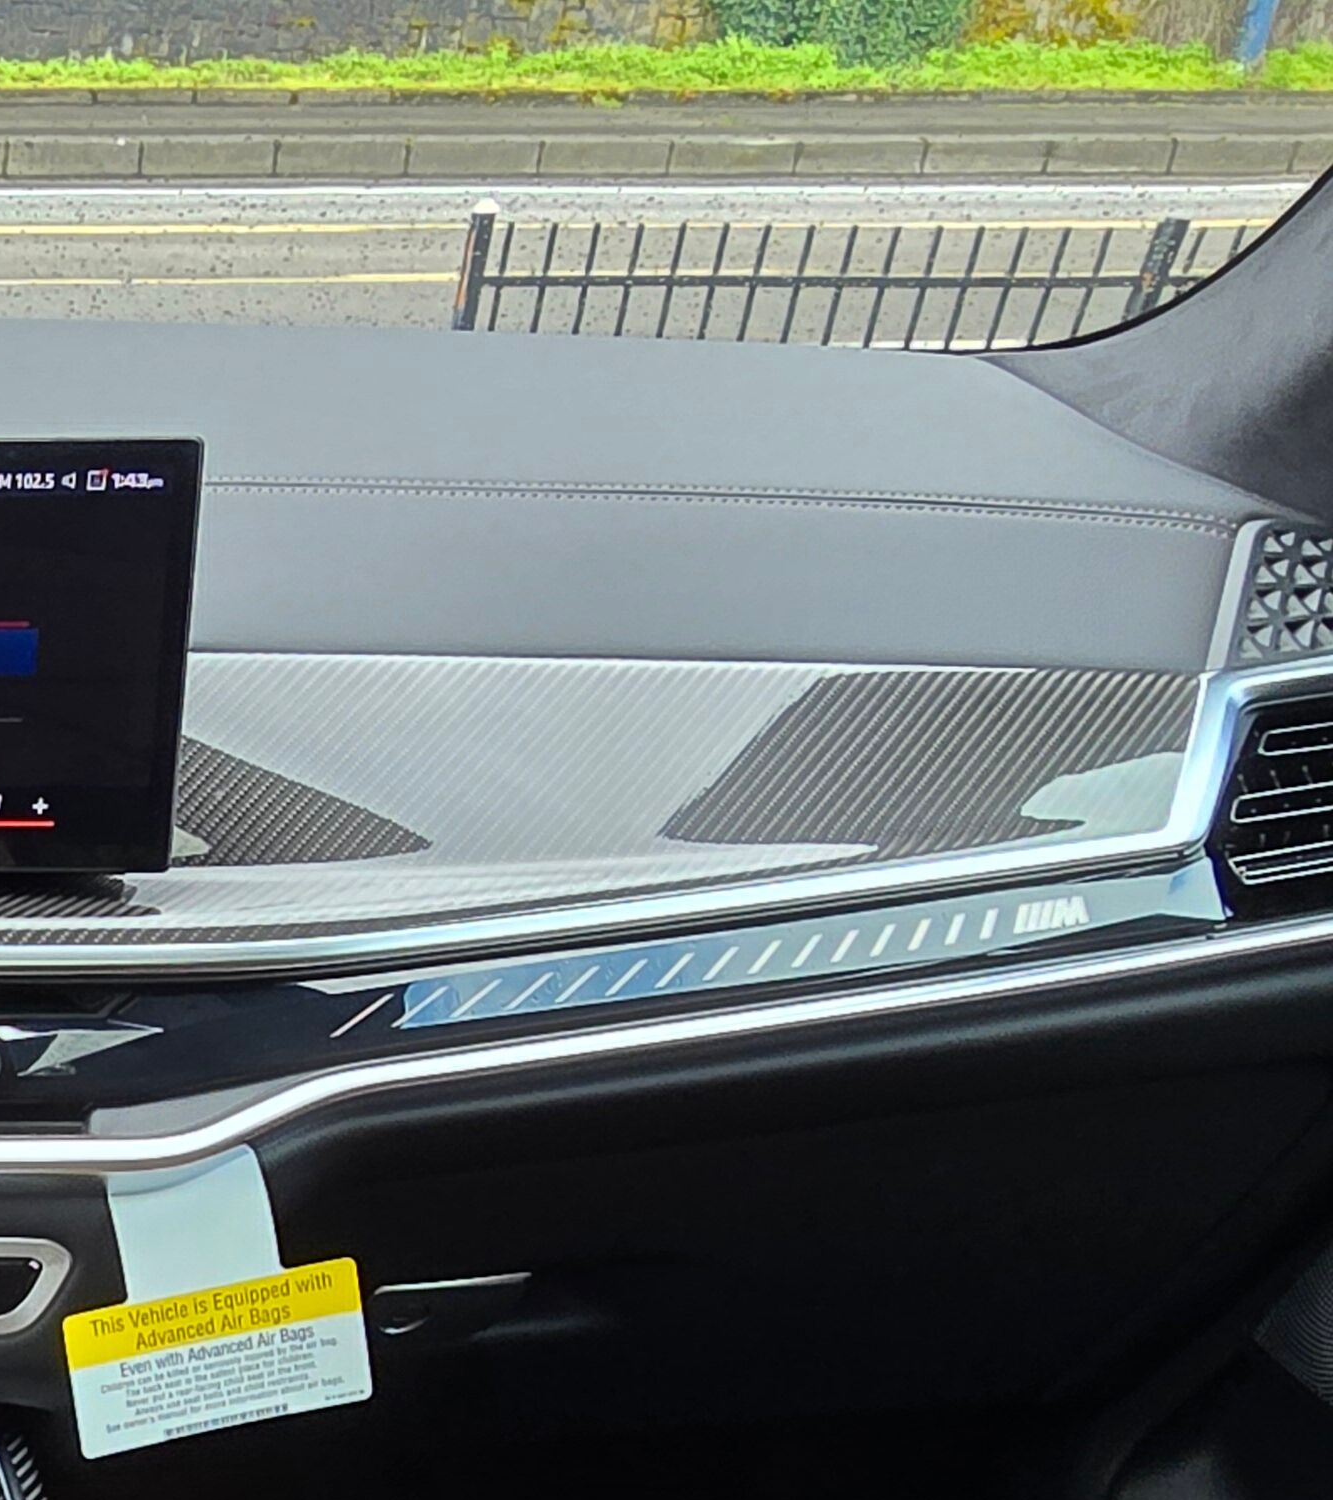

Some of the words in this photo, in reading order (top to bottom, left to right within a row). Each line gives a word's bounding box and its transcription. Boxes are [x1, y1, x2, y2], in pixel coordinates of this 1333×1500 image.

[15, 473, 55, 489] 102.5
[89, 1318, 125, 1338] This
[128, 1302, 188, 1329] Vehicle
[194, 1298, 207, 1315] is
[213, 1282, 290, 1312] Equipped
[295, 1272, 332, 1295] with
[136, 1318, 215, 1350] Advanced
[221, 1311, 243, 1331] Air
[250, 1304, 290, 1326] Bags
[120, 1361, 152, 1378] Even
[155, 1352, 184, 1369] with
[187, 1336, 253, 1362] Advanced
[257, 1331, 276, 1347] Air
[280, 1325, 314, 1343] Bags
